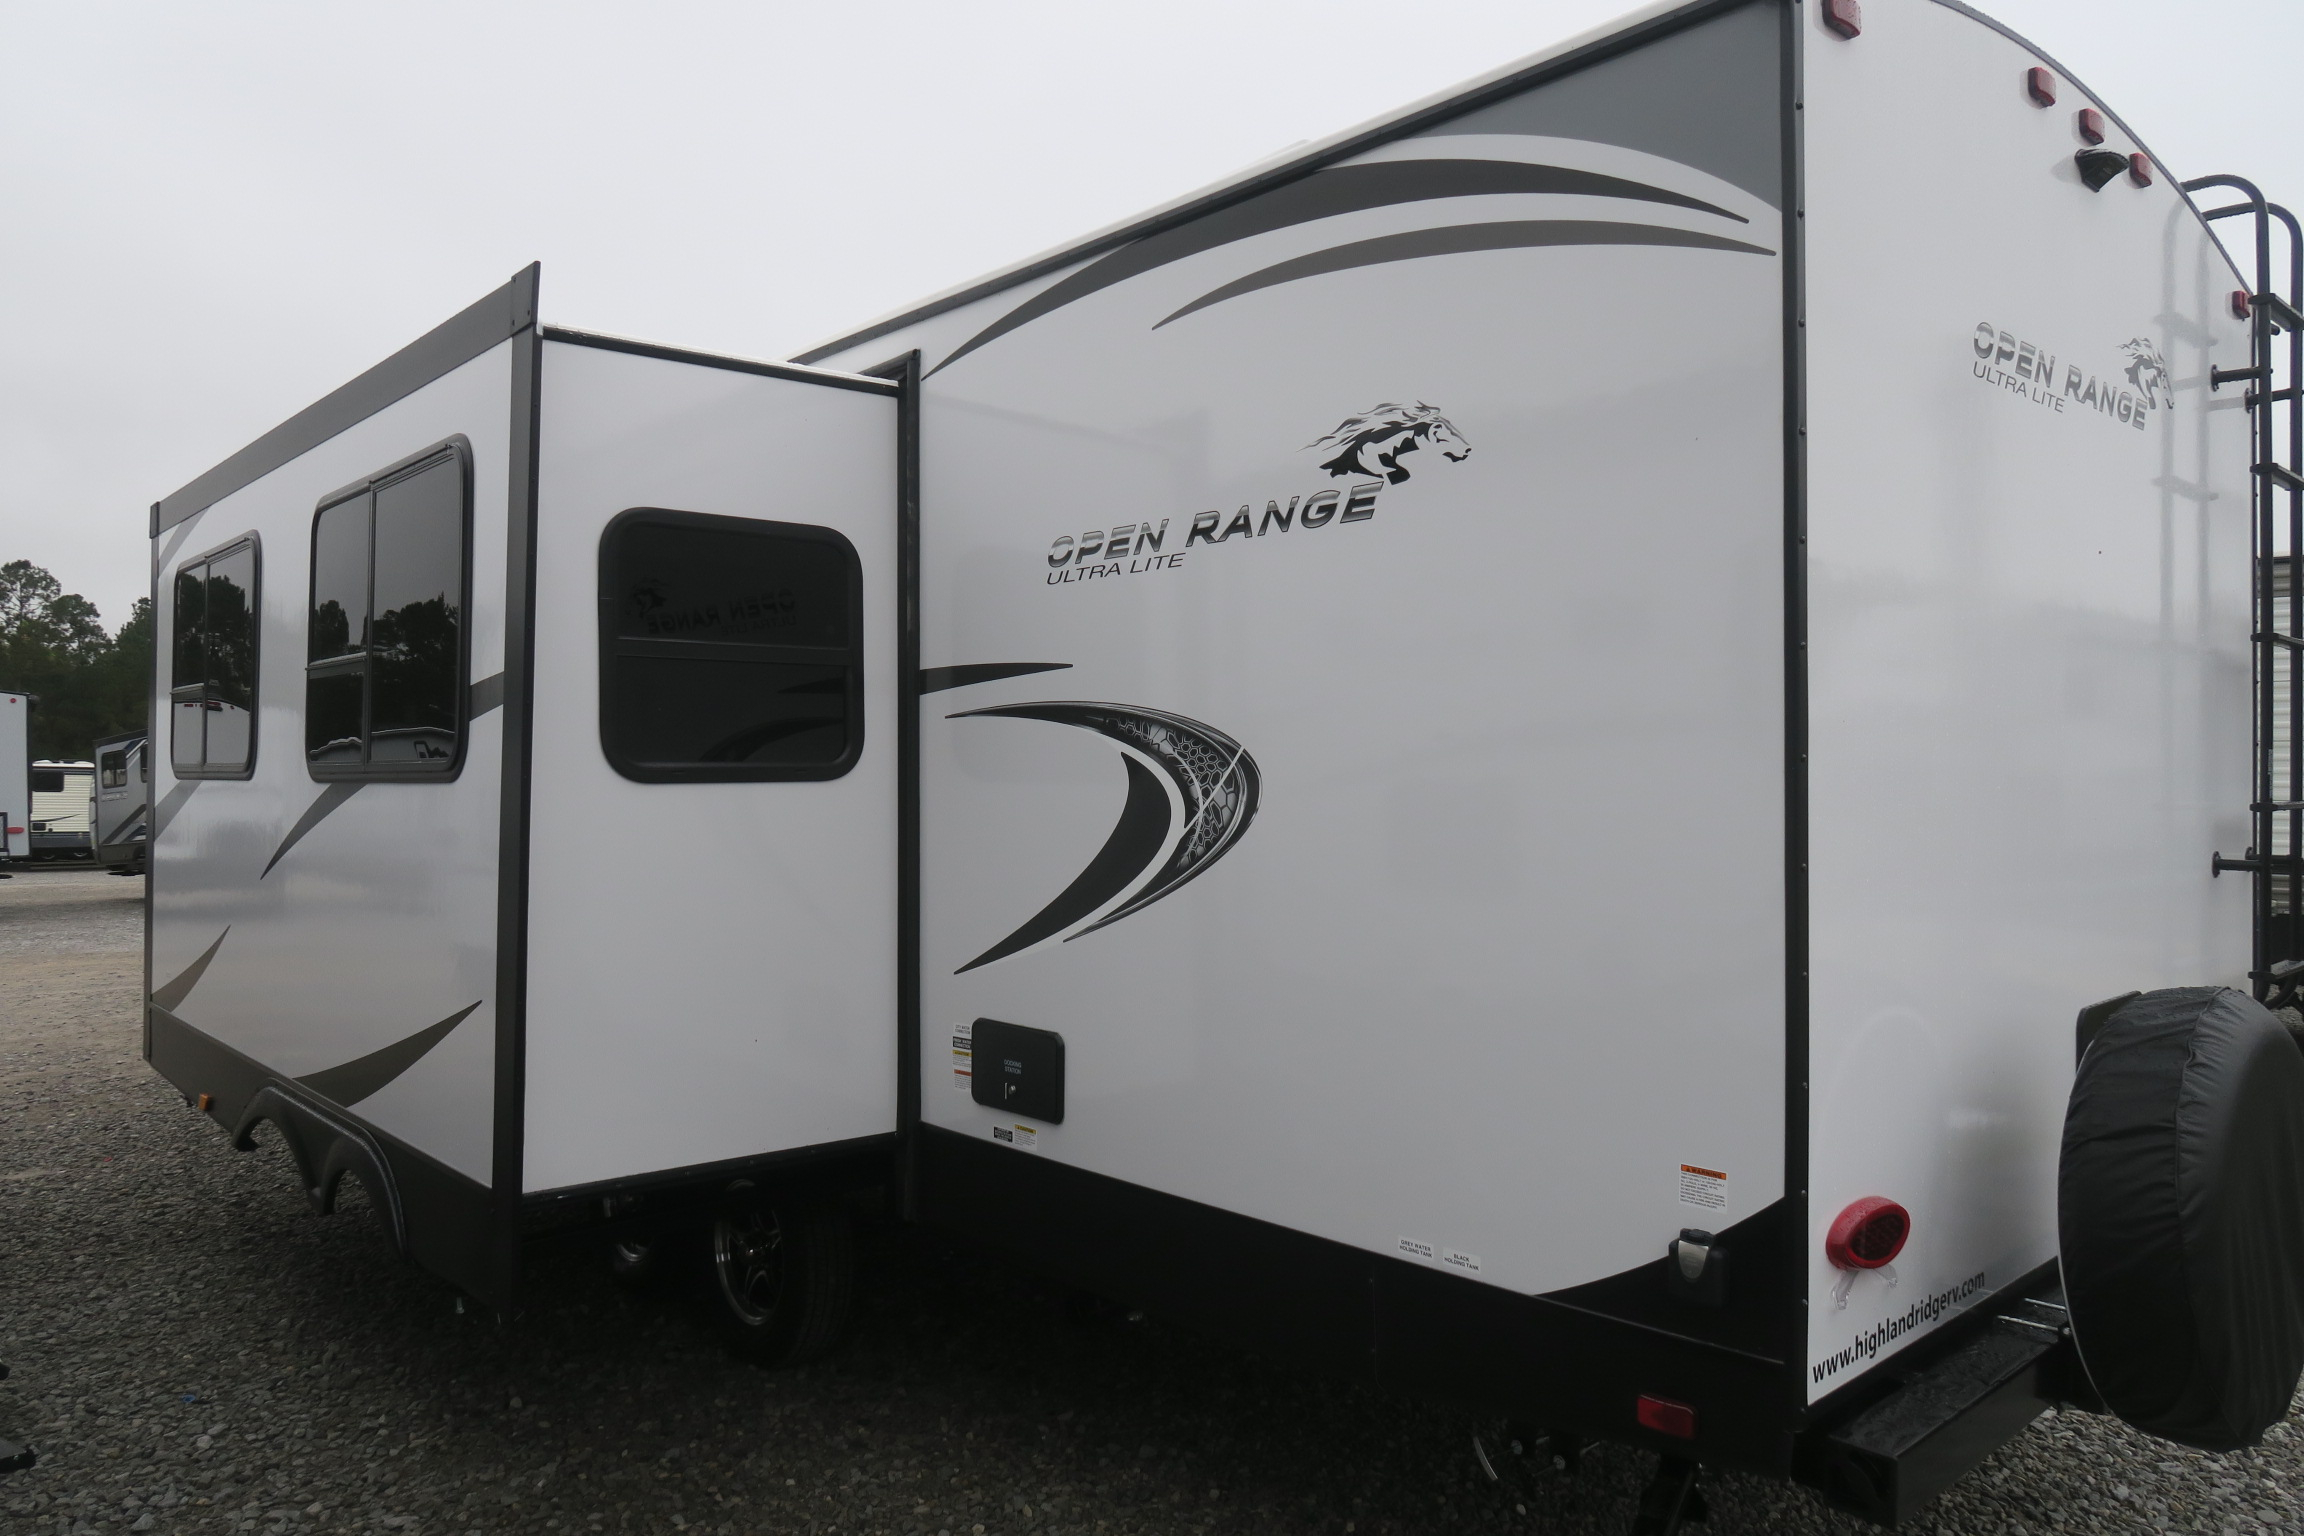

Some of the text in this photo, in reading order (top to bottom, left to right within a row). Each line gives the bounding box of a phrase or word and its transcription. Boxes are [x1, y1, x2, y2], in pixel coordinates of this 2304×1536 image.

[1973, 321, 2148, 431] OPEN RANGE
[1973, 360, 2065, 413] ULTRA LITE
[1047, 481, 1384, 568] OPEN RANGE
[1046, 552, 1186, 585] ULTRA LITE
[1400, 1245, 1432, 1258] HOLDING TANK
[1414, 1243, 1431, 1252] WATER
[1444, 1257, 1479, 1271] HOLDING TANK
[1453, 1253, 1469, 1262] BLACK
[1812, 1272, 1985, 1384] www.highlandridgerv.com
